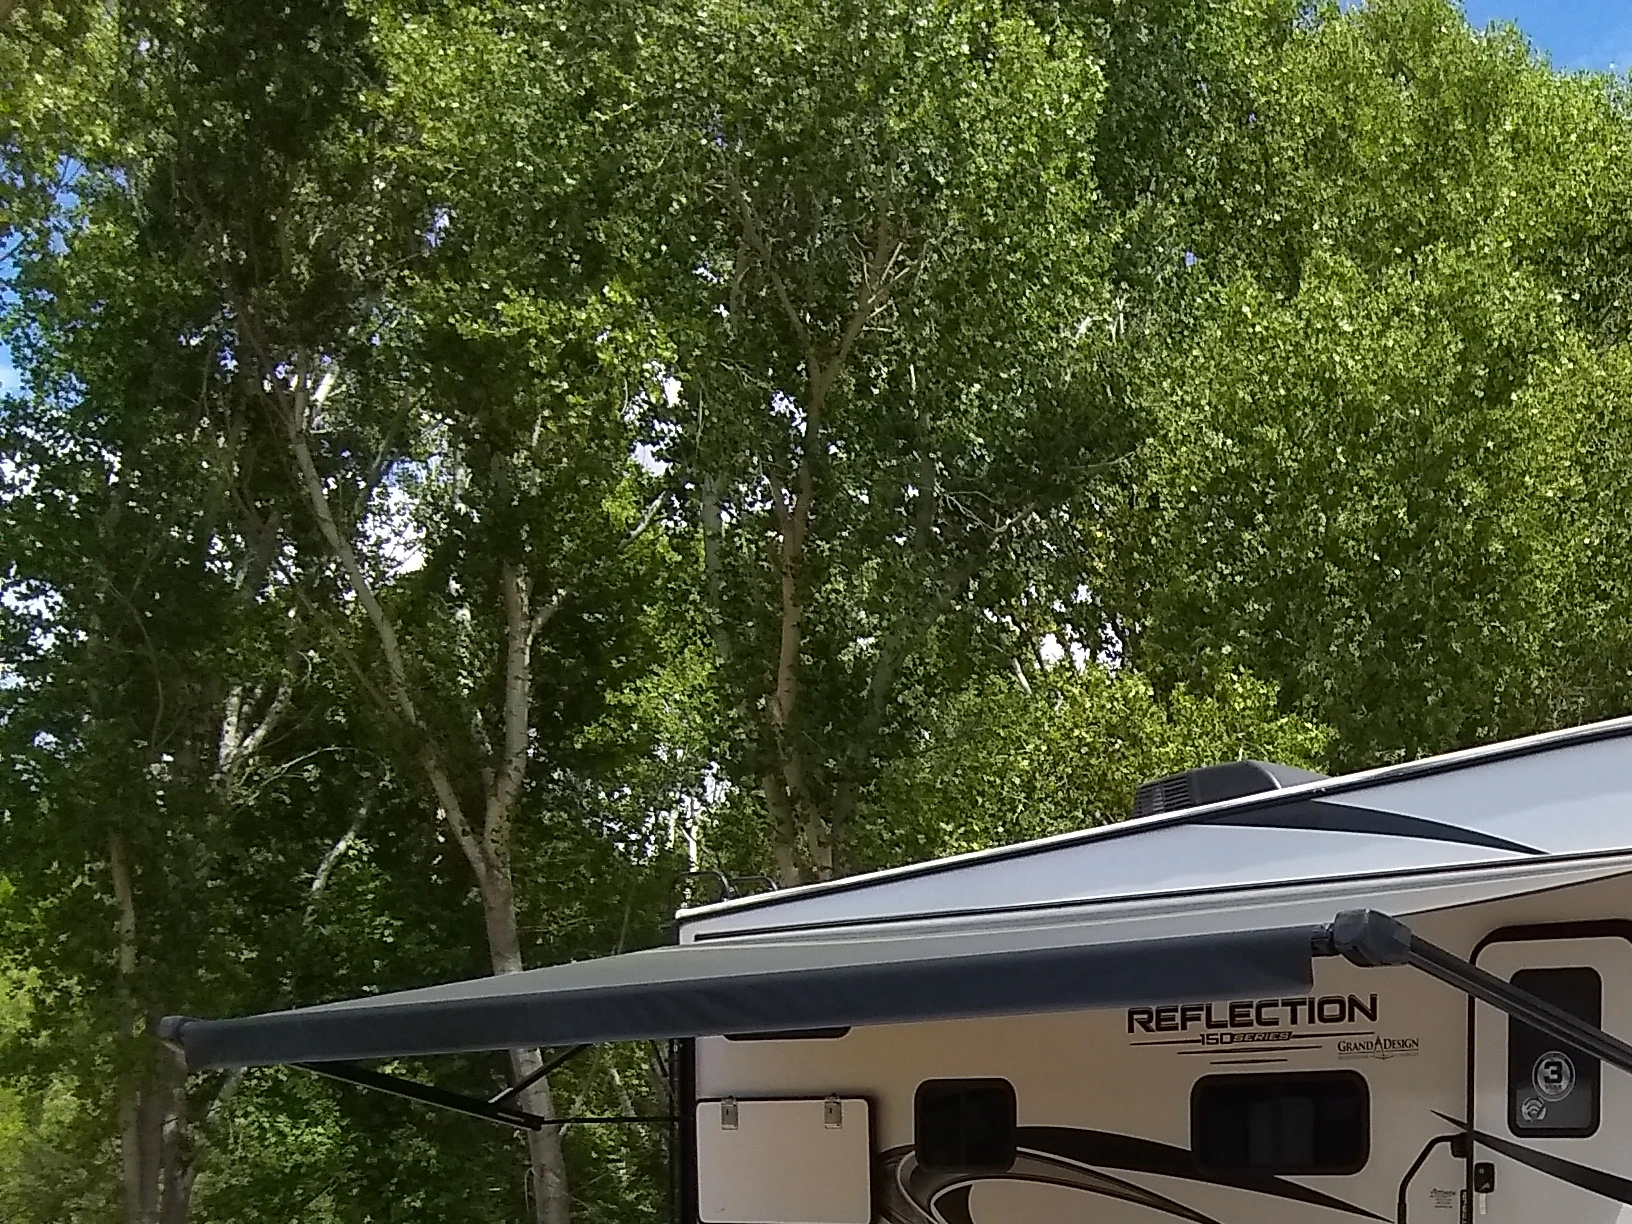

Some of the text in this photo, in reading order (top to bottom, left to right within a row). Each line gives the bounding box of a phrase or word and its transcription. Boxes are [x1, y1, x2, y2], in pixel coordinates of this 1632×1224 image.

[1127, 993, 1378, 1034] REFLECTION
[1337, 1038, 1419, 1052] GRAND DESIGN
[1544, 1061, 1563, 1084] 3
